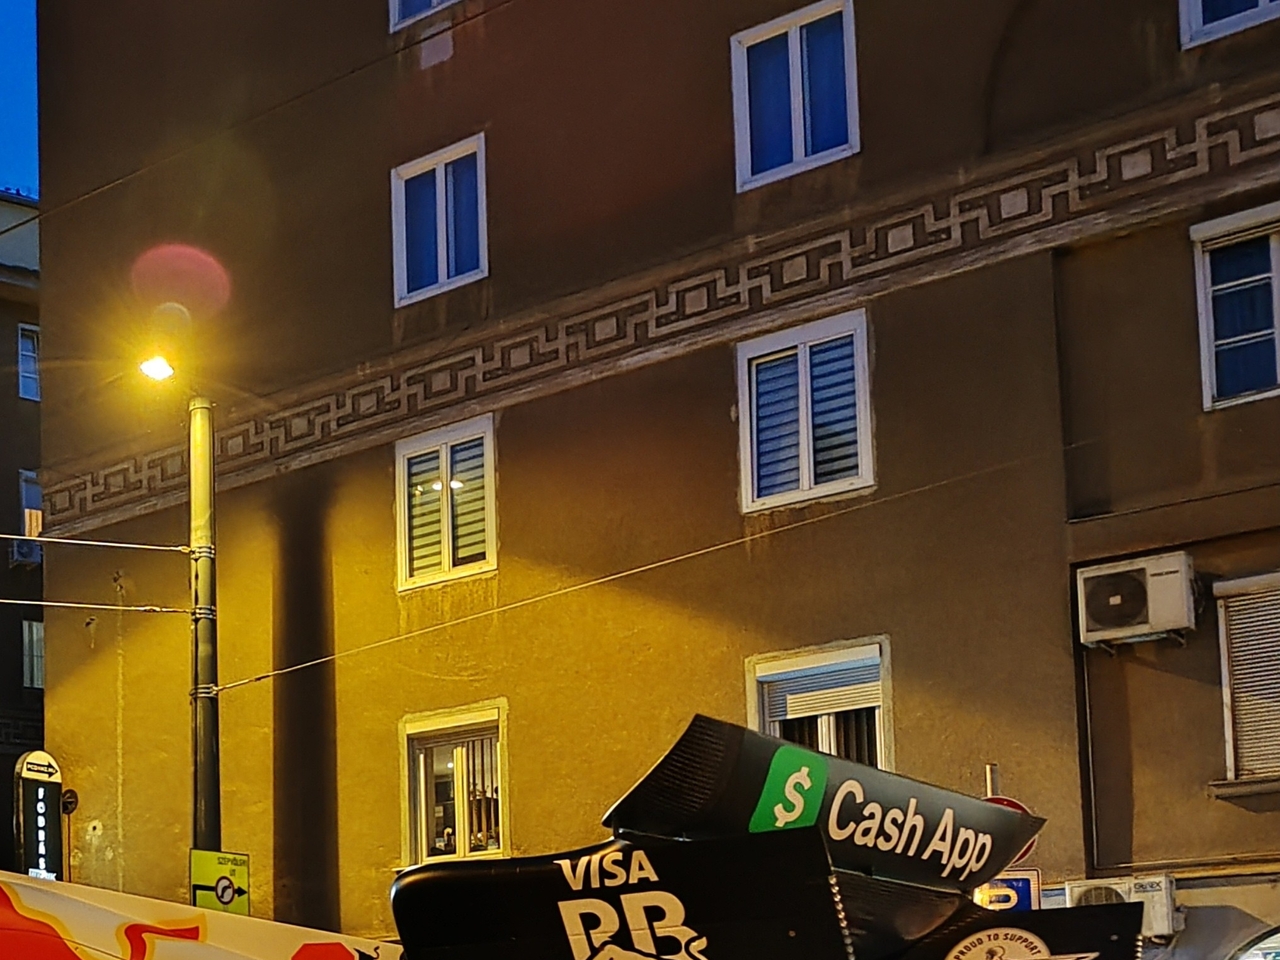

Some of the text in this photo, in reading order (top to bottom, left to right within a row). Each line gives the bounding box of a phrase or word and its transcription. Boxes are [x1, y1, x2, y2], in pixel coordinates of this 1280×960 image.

[828, 779, 924, 857] Cash
[921, 808, 992, 881] App
[553, 850, 659, 890] VISA
[986, 932, 1000, 942] TO
[1002, 932, 1042, 956] SUPPORT
